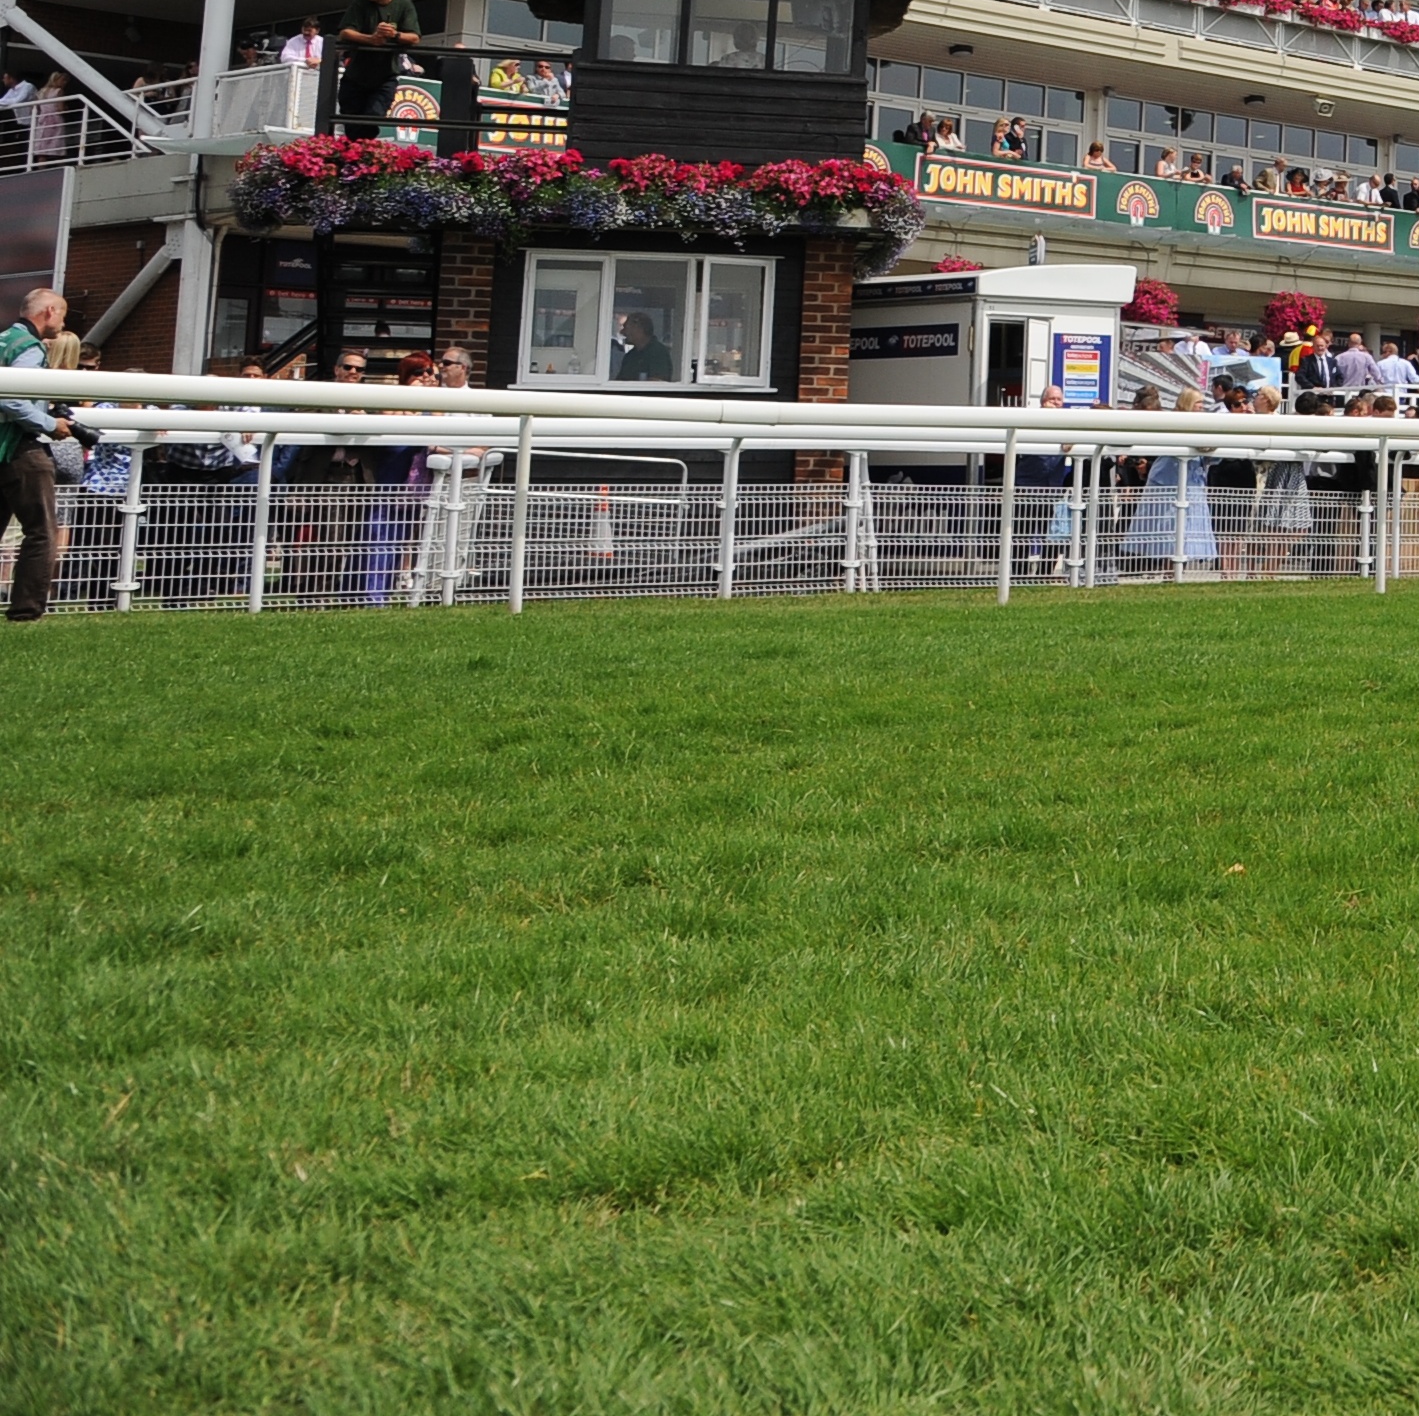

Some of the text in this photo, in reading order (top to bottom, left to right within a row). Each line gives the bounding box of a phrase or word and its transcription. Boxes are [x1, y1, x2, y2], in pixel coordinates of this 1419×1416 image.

[924, 163, 1088, 209] JOHN SMITH'S
[1260, 206, 1387, 244] JOHN SMITH'S
[935, 282, 964, 292] TOTEPOOL
[850, 333, 956, 351] EPOOL TOTEPOOL
[1062, 335, 1103, 345] TOTEPOOL
